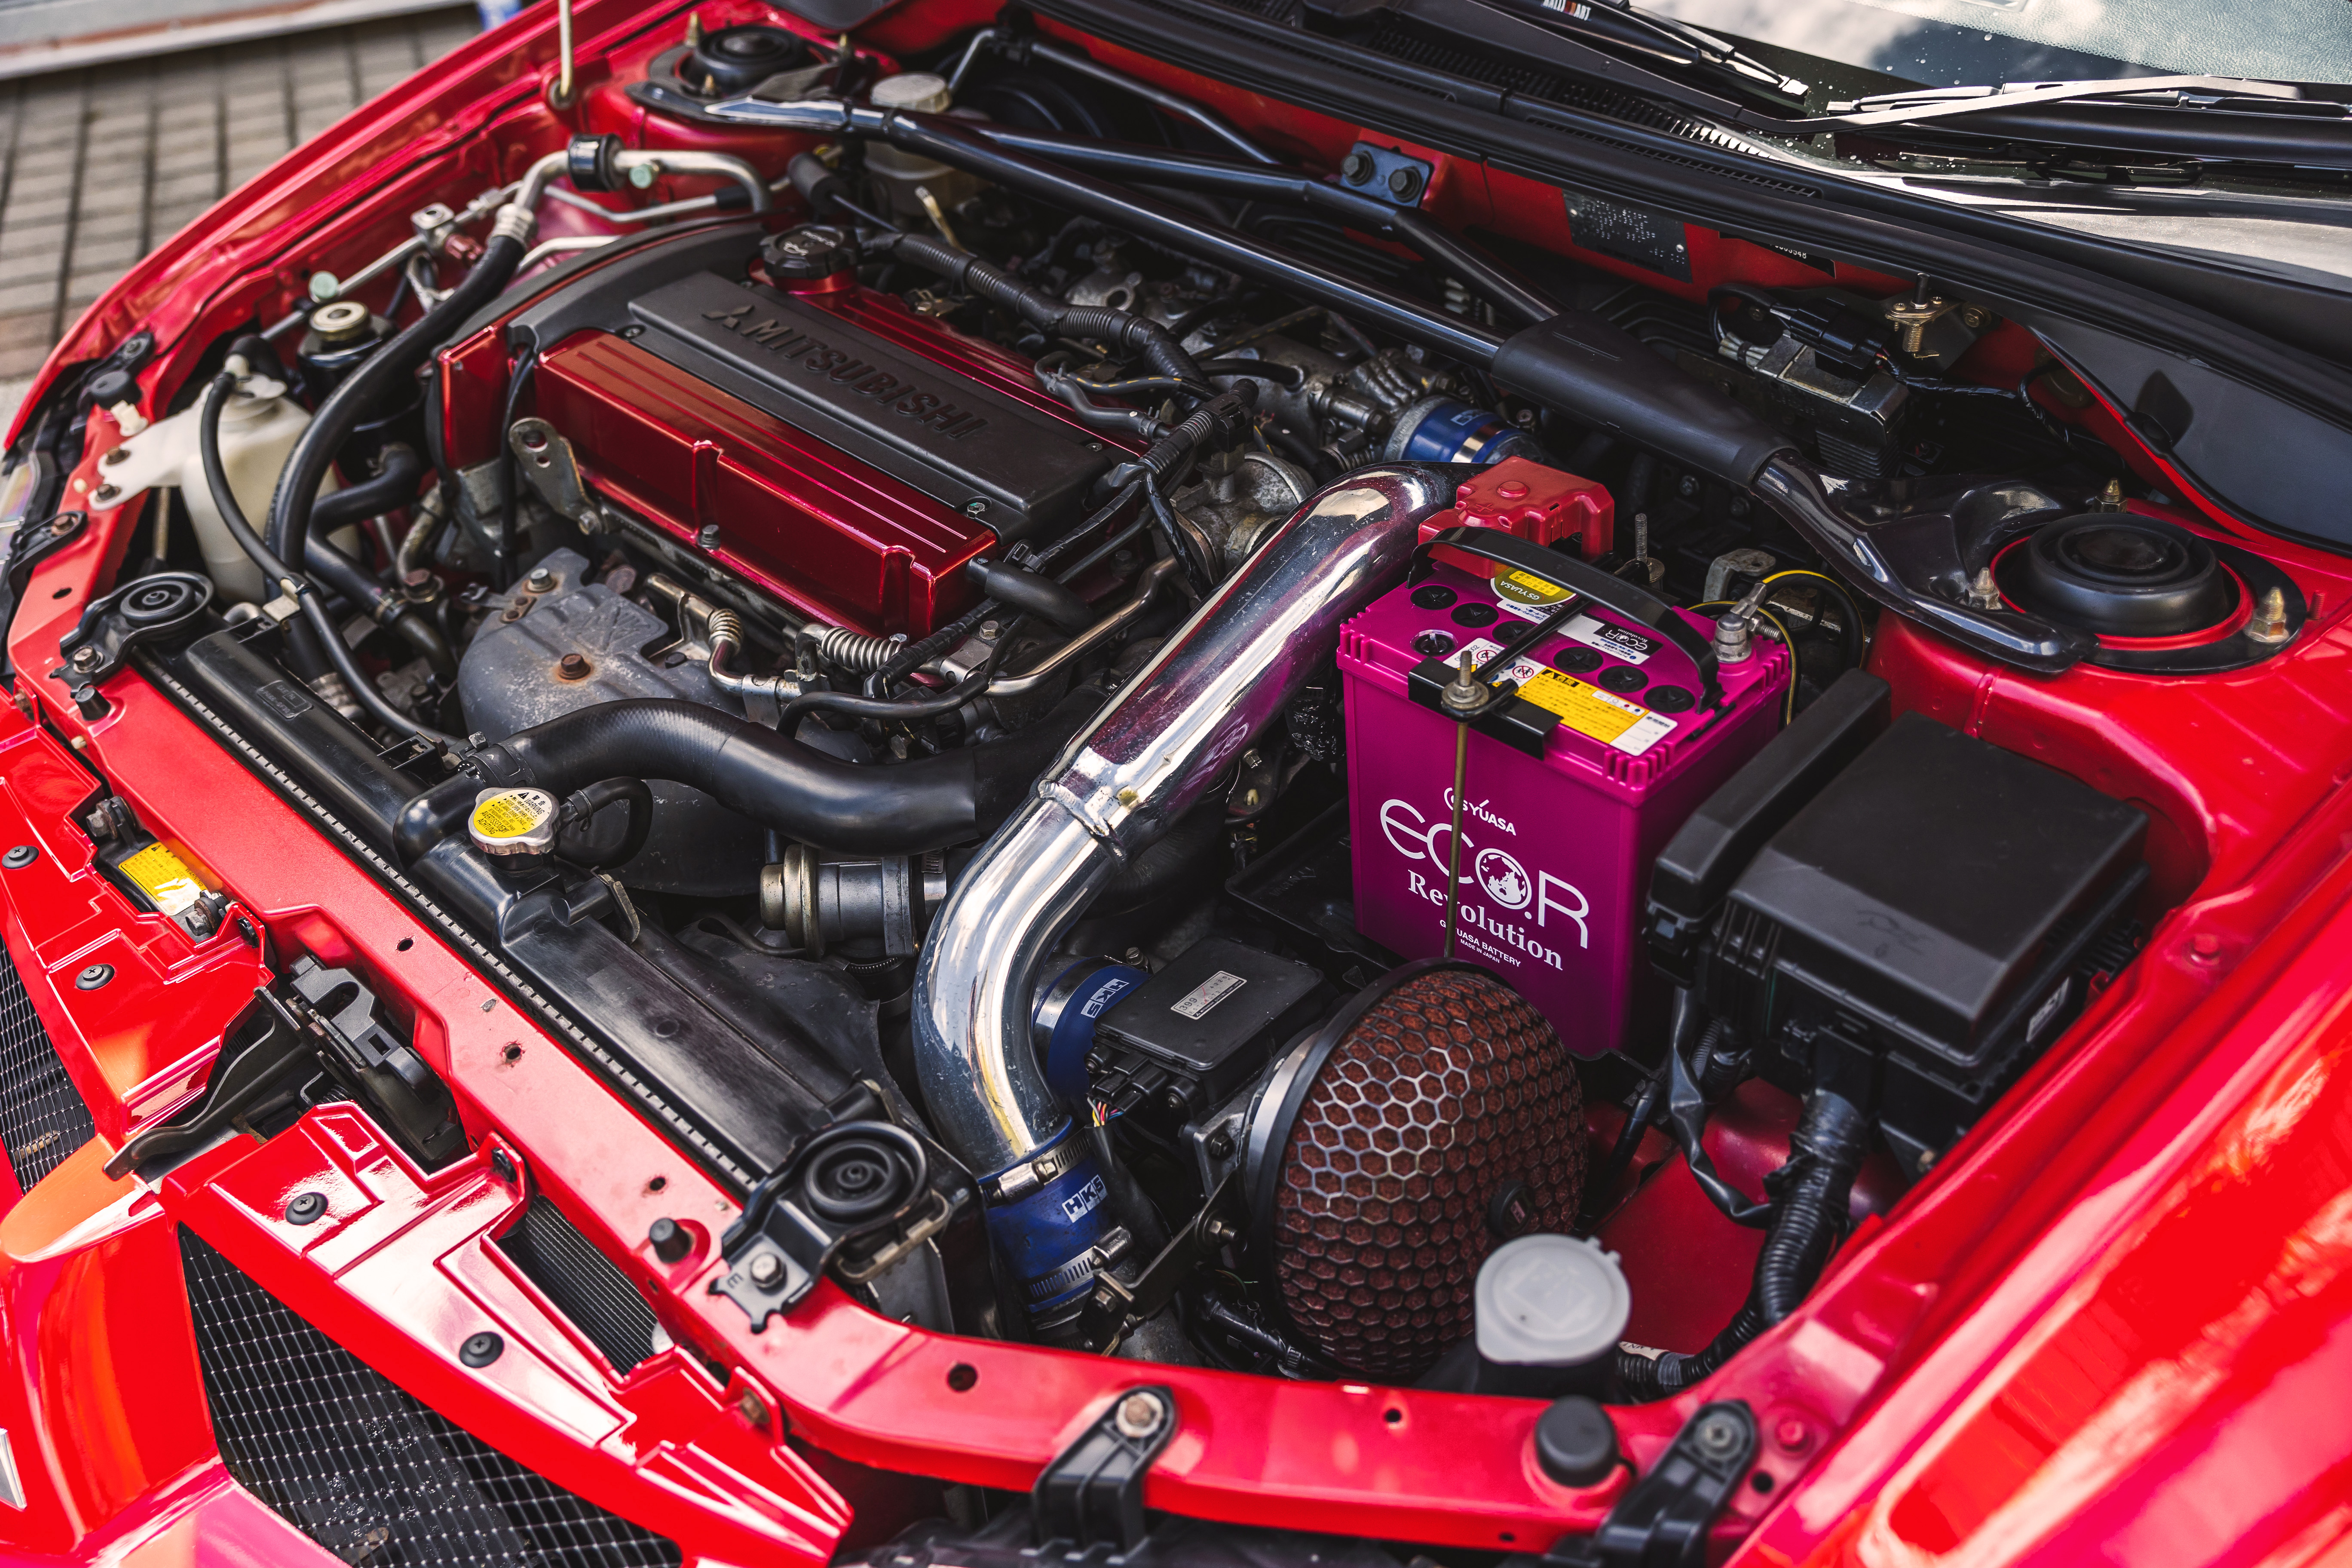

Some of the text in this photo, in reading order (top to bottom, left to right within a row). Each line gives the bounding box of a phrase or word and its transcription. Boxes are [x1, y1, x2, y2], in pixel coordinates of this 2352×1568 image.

[740, 319, 990, 441] MITSUBISHI
[1618, 628, 1648, 643] Revolution
[524, 798, 545, 815] WARNING
[477, 818, 498, 835] ACHTUNG
[481, 811, 510, 833] AVERTISSEMENT
[185, 868, 204, 887] WARNING
[1455, 927, 1480, 946] UASA
[1482, 941, 1521, 967] BATTERY
[1461, 939, 1476, 950] MADE
[1482, 951, 1500, 963] JAPAN
[1082, 979, 1129, 1018] HKS
[1179, 998, 1197, 1011] 399
[1063, 1175, 1107, 1221] HKS
